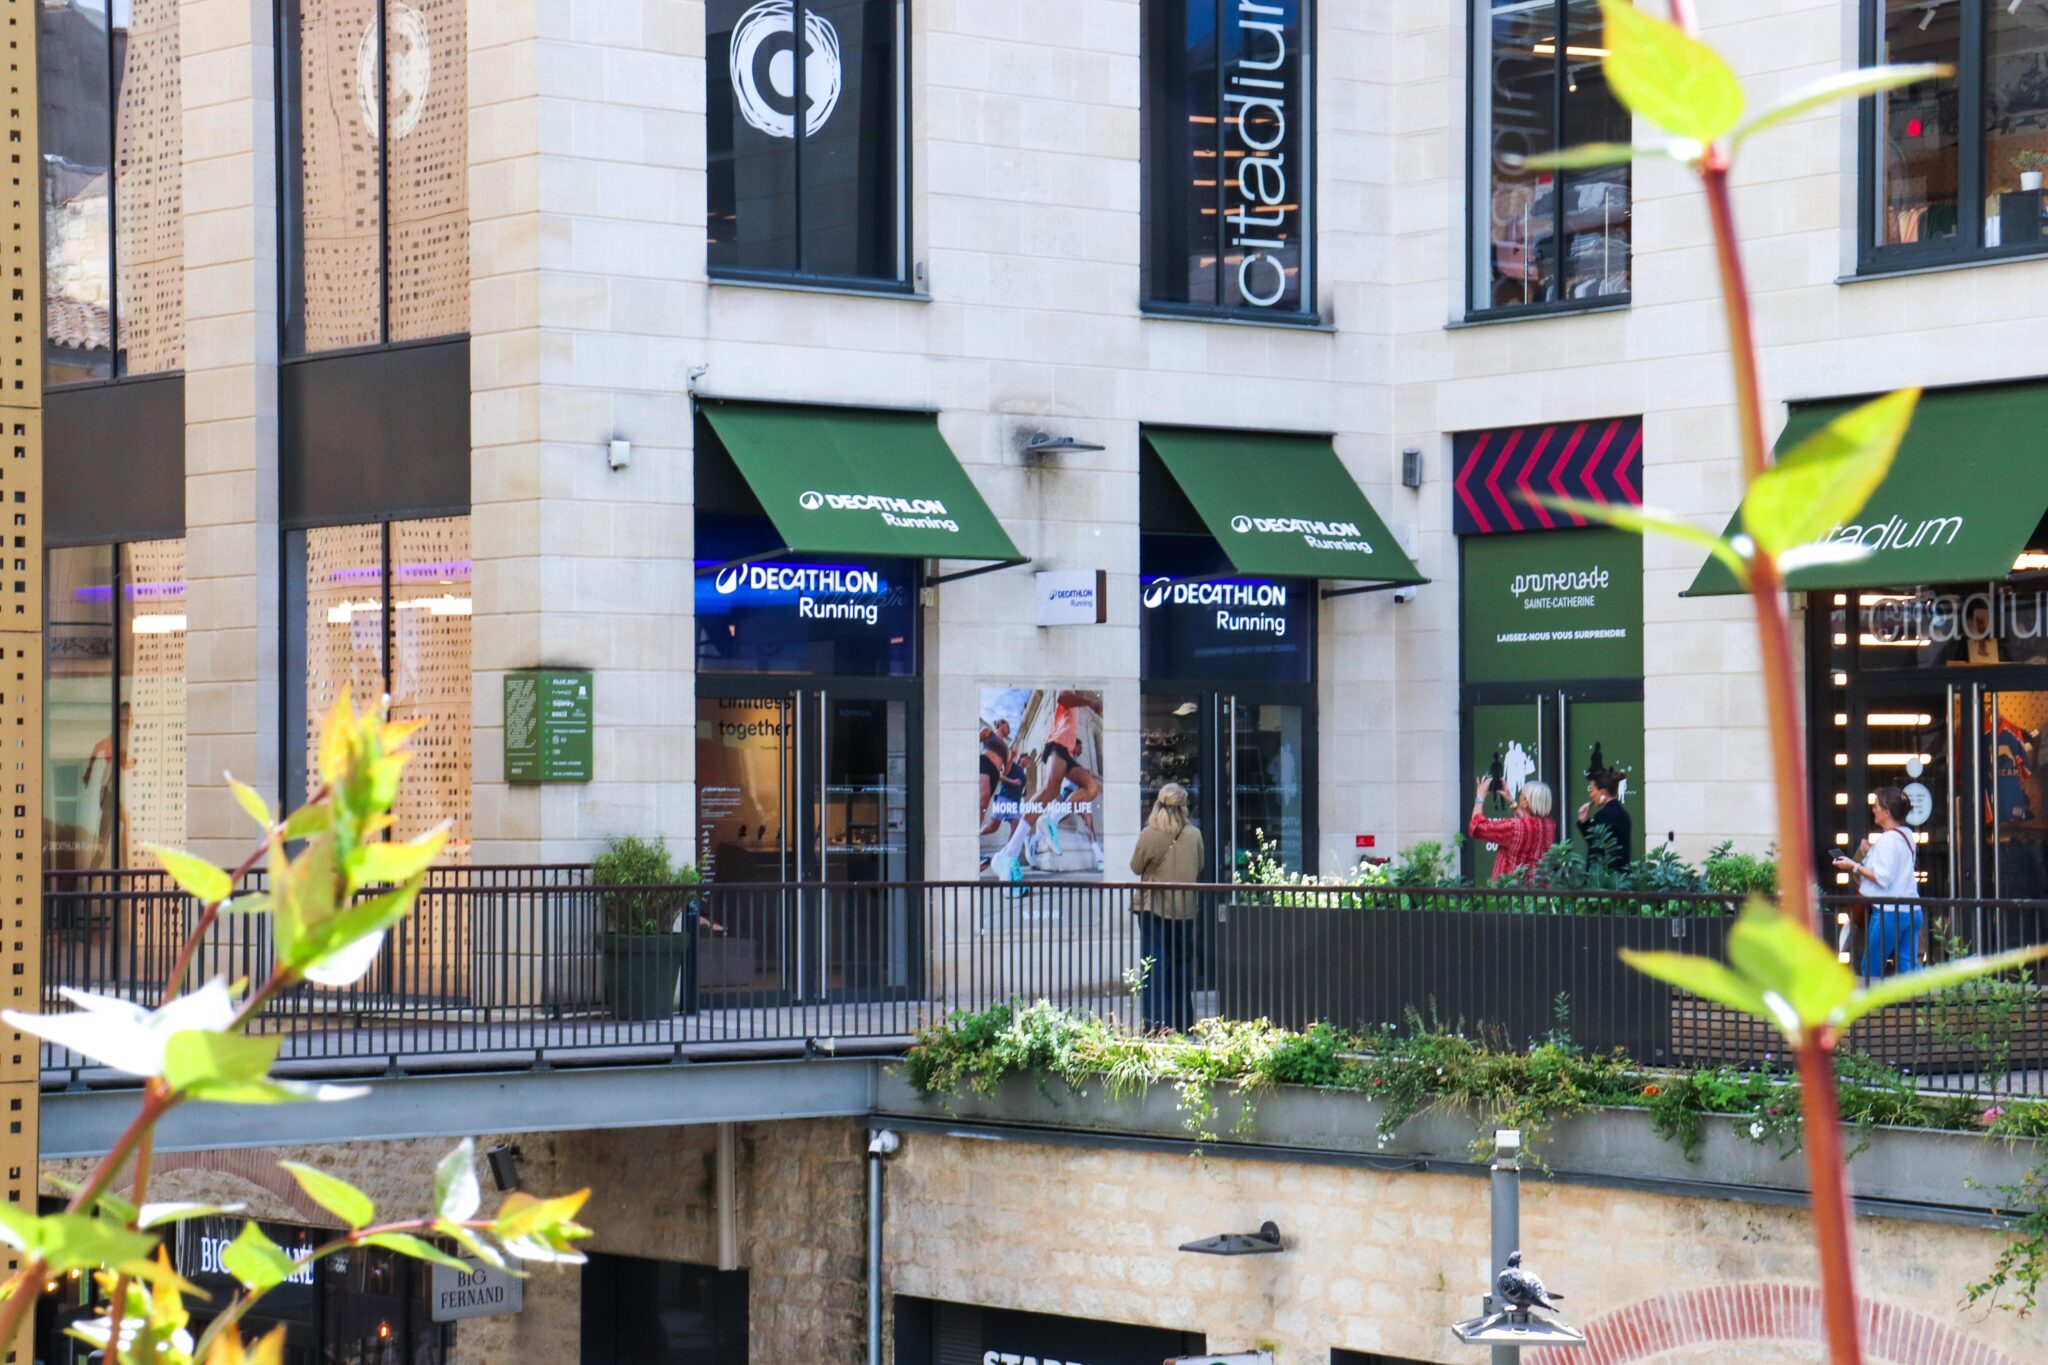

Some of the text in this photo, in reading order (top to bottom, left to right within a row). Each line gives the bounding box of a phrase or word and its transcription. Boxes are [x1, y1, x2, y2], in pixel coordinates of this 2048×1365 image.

[825, 494, 948, 515] DECATHLON
[881, 512, 960, 533] Running
[1253, 517, 1362, 537] DECATHLON
[1304, 535, 1374, 554] Running
[749, 566, 878, 594] DECATHLON
[1510, 565, 1609, 598] promenade
[1057, 589, 1093, 599] DECATHLON
[1070, 599, 1093, 608] Running
[1173, 583, 1286, 606] DECATHLON
[1523, 595, 1596, 610] SAINTE-CATHERINE
[799, 597, 878, 625] Running
[1868, 581, 2048, 643] citadiu
[1216, 611, 1286, 637] Running
[1497, 628, 1627, 643] LAISSEZ-NOUS VOUS SURPRENDRE
[718, 718, 792, 740] together
[992, 801, 1018, 814] MORE
[1047, 801, 1073, 814] MORE
[1074, 801, 1092, 813] LIFE
[441, 1285, 504, 1310] FERNAND
